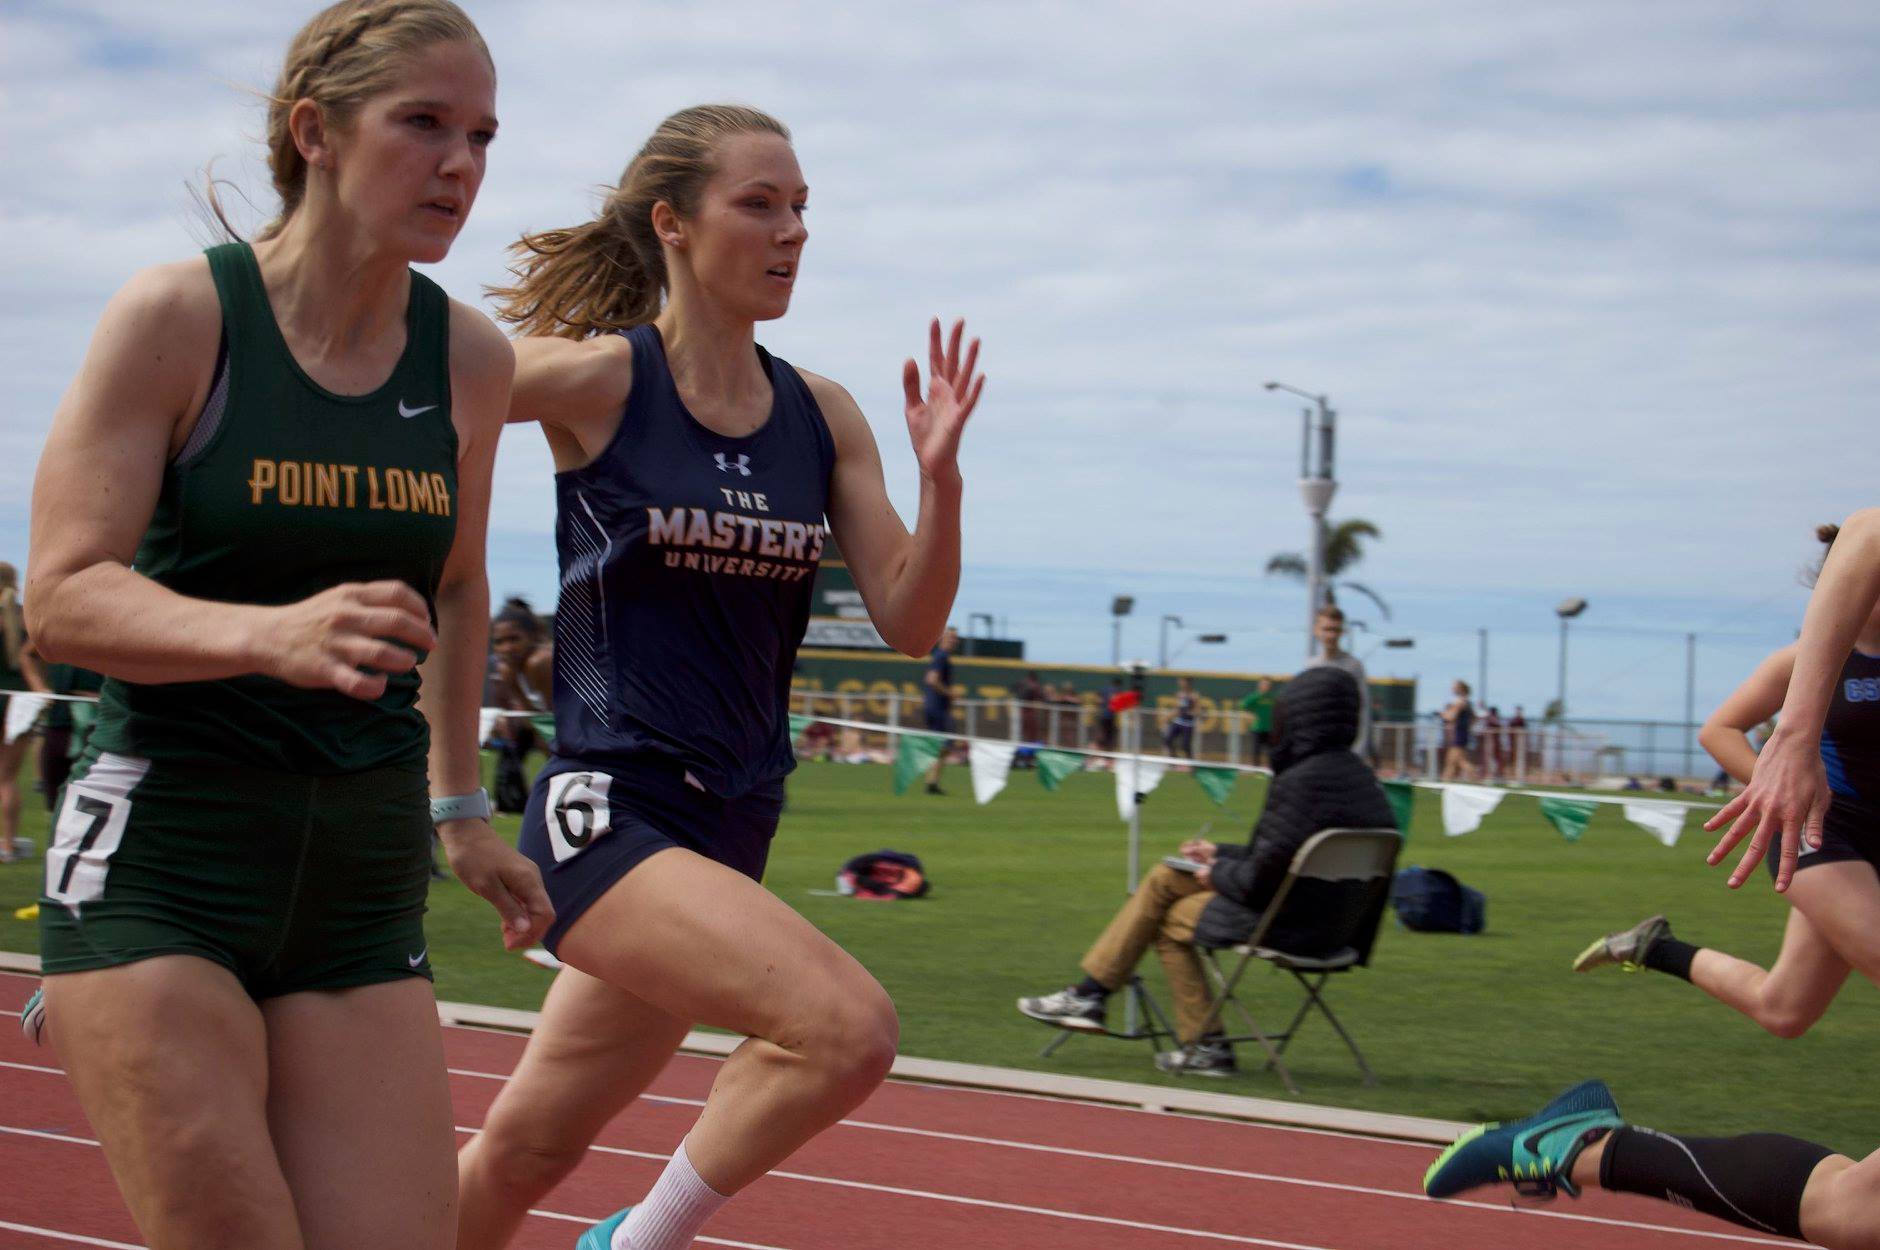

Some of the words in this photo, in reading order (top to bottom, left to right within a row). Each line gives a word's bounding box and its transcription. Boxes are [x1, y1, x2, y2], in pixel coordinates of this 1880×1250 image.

[248, 459, 359, 509] POINT
[367, 466, 450, 517] LOMA
[720, 487, 770, 512] THE
[646, 507, 825, 563] MASTER'S
[664, 551, 811, 582] UNIVERSITY
[555, 774, 594, 848] 6
[58, 794, 115, 894] 7
